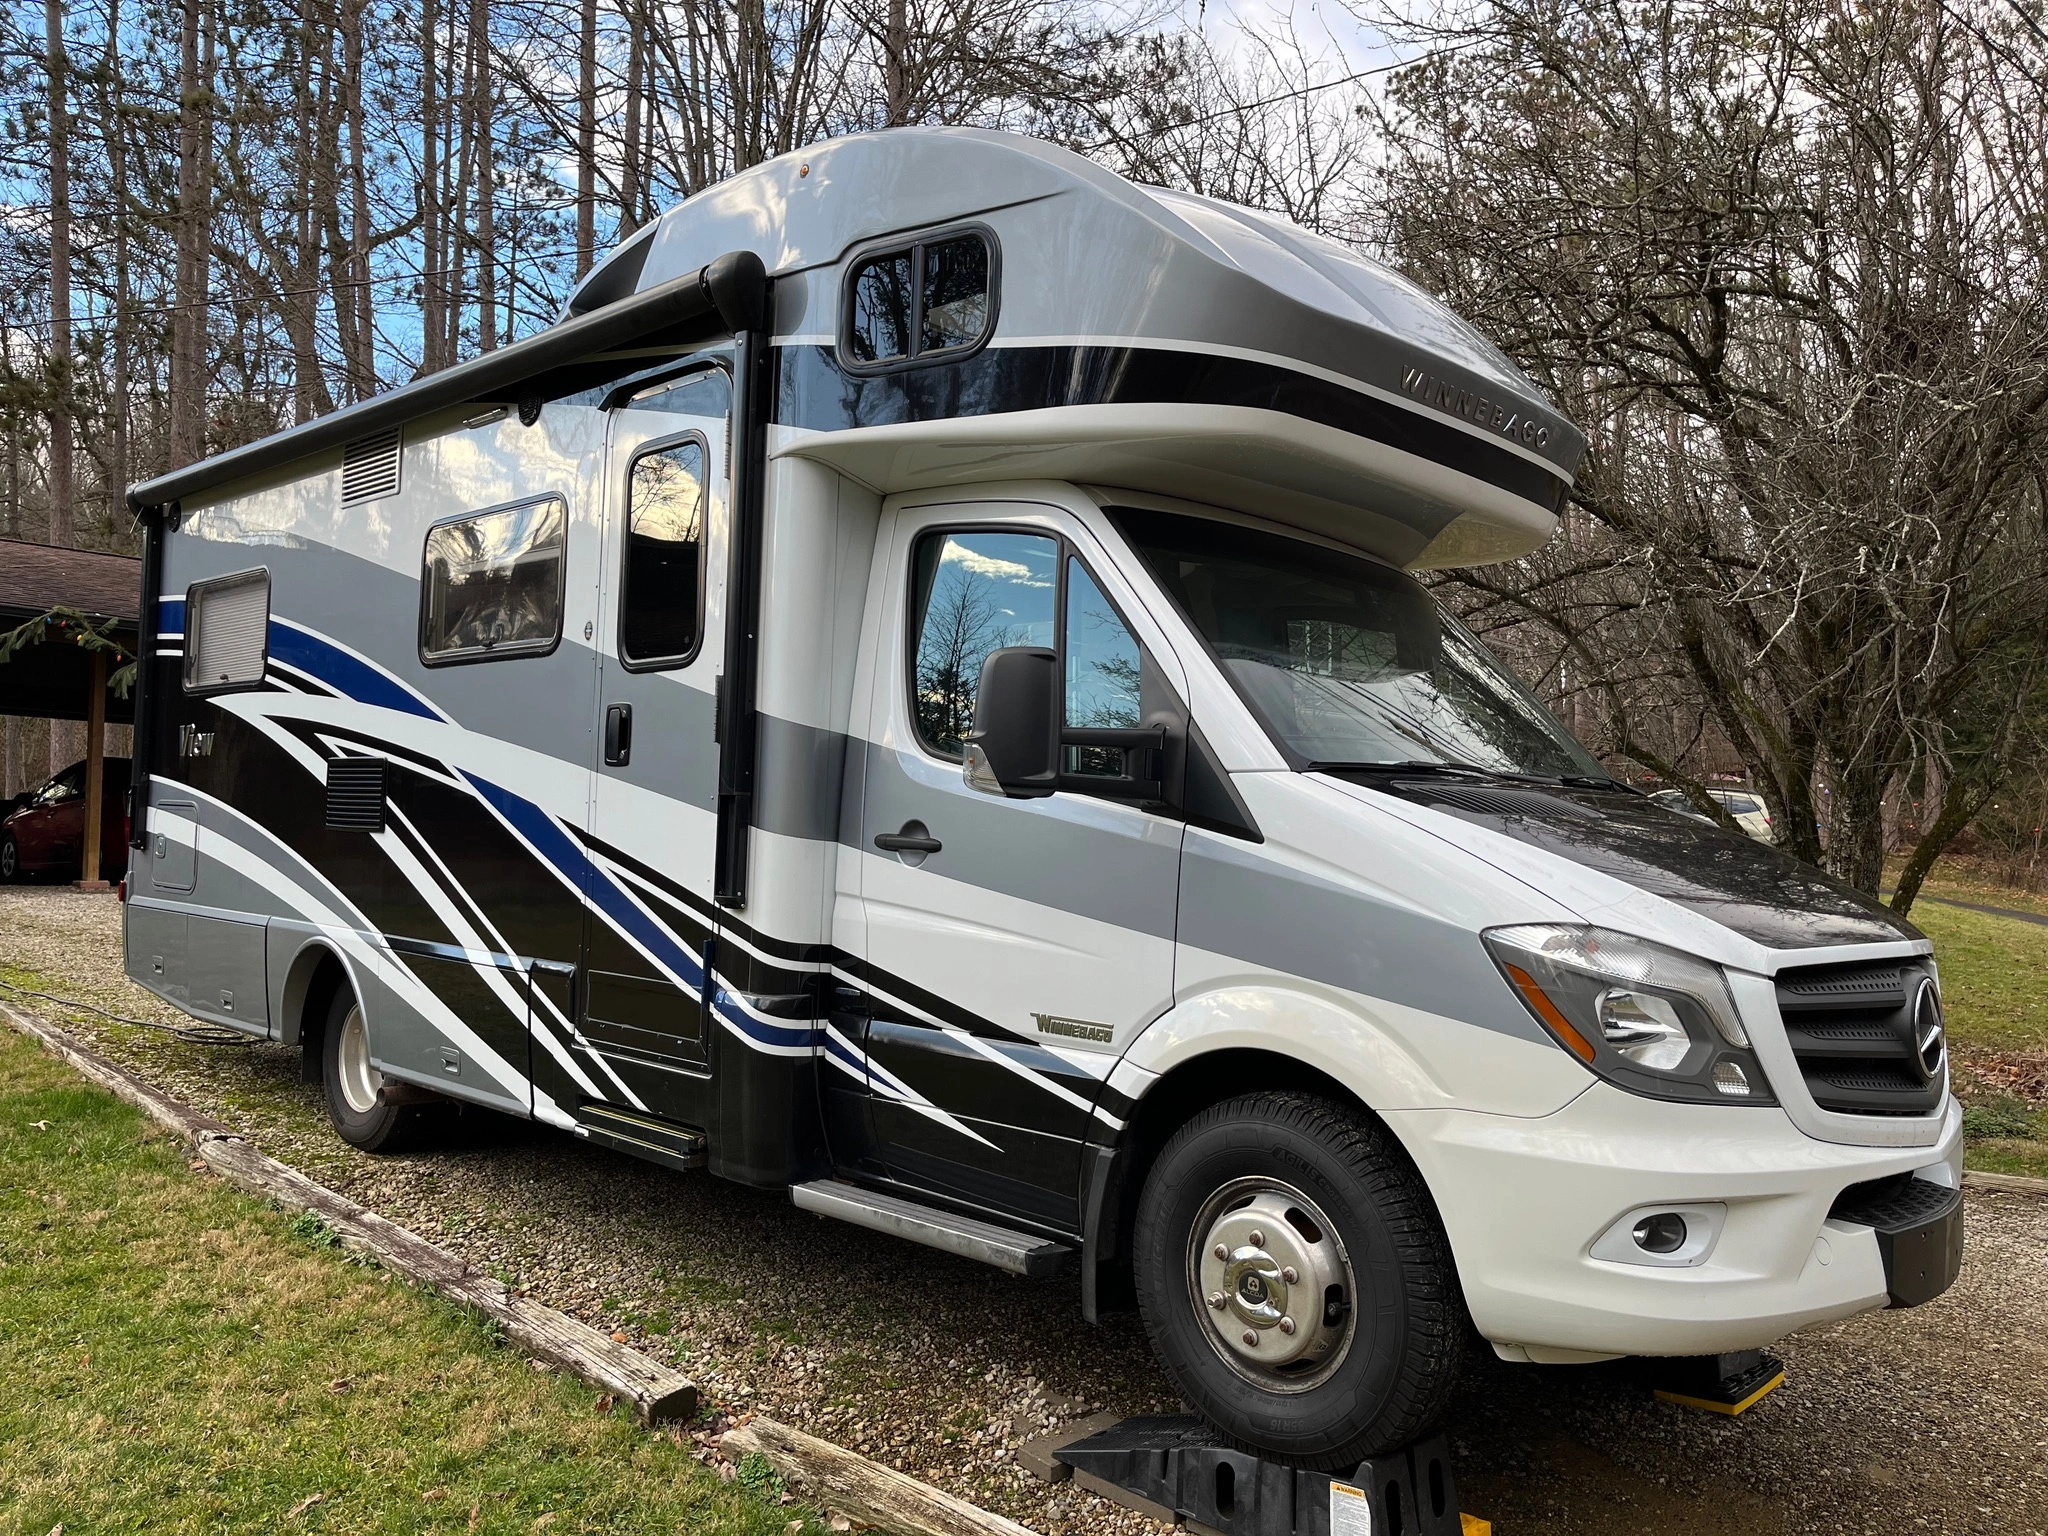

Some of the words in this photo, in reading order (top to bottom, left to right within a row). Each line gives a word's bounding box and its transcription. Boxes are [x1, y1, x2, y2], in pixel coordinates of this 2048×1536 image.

[1400, 364, 1549, 449] WINNEBAGO
[179, 723, 215, 757] View
[1278, 1148, 1320, 1181] AGILIS
[1240, 1287, 1265, 1299] ALCOA
[1341, 1487, 1363, 1497] WARNING
